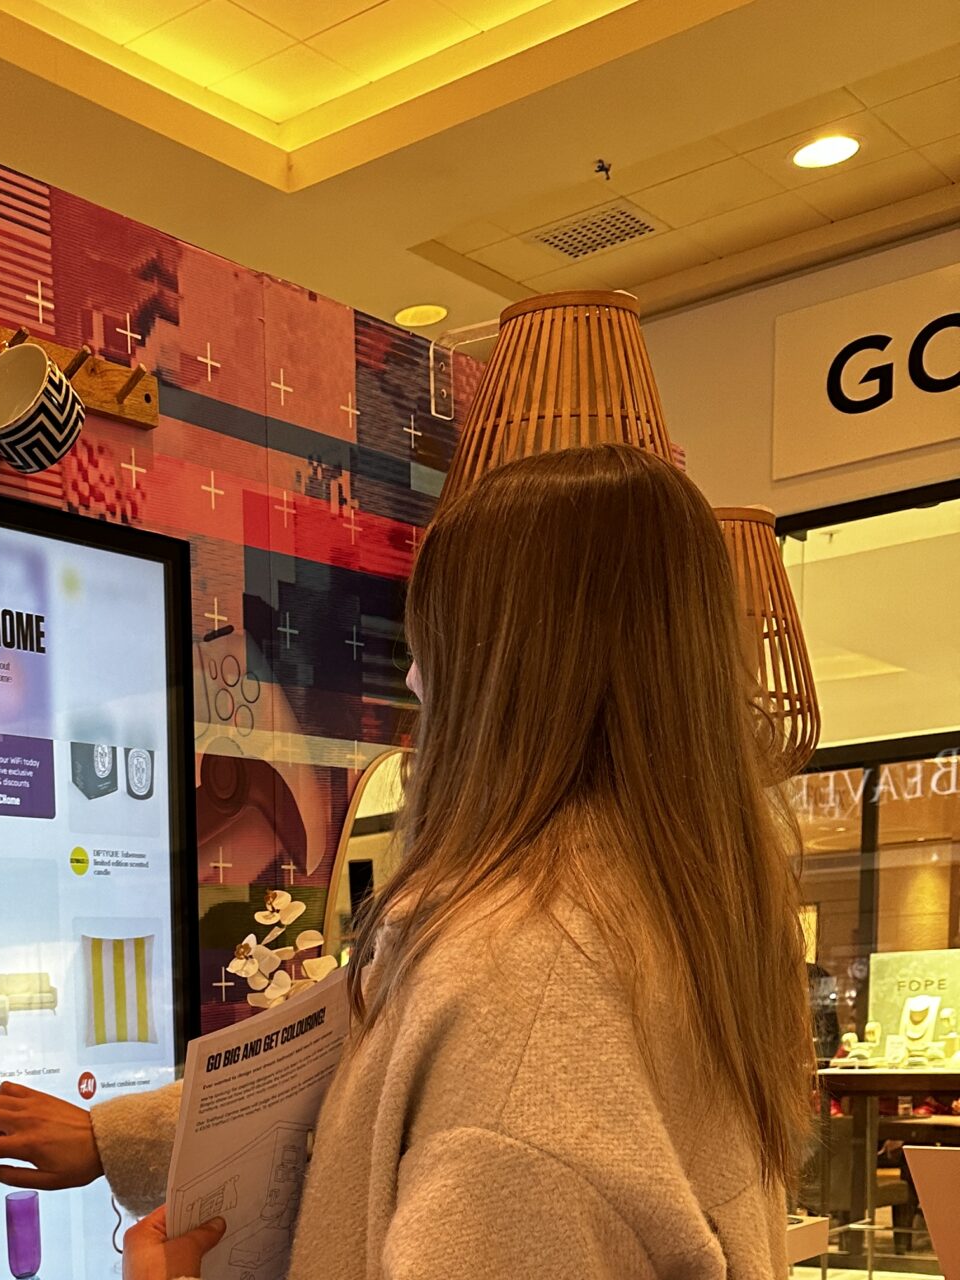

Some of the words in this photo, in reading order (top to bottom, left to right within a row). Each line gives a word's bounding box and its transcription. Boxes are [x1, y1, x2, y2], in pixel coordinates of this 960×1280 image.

[0, 662, 10, 670] out
[23, 758, 40, 768] today
[2, 778, 30, 788] discounts
[897, 978, 947, 992] FOPE
[206, 1052, 222, 1073] GO
[222, 1046, 241, 1068] BIG
[241, 1038, 262, 1061] AND
[263, 1030, 280, 1052] GET
[280, 1006, 326, 1045] COLOURING!
